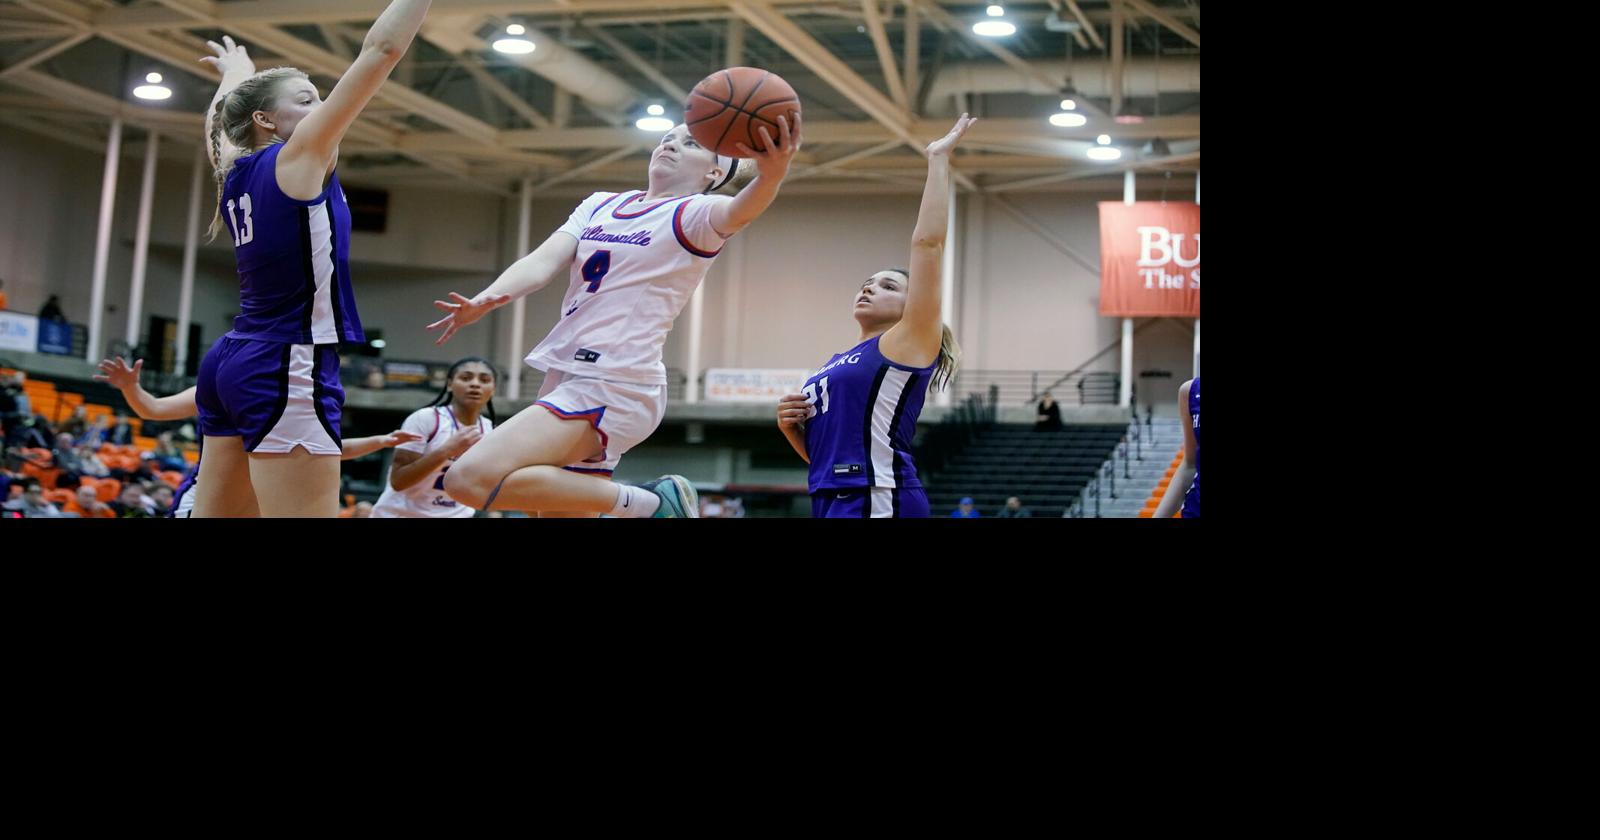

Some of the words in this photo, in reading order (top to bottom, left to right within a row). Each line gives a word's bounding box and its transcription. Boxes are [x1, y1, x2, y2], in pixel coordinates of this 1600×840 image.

[226, 192, 254, 247] 13
[580, 224, 652, 246] illiamsville
[581, 249, 612, 293] 4
[1138, 267, 1184, 289] The
